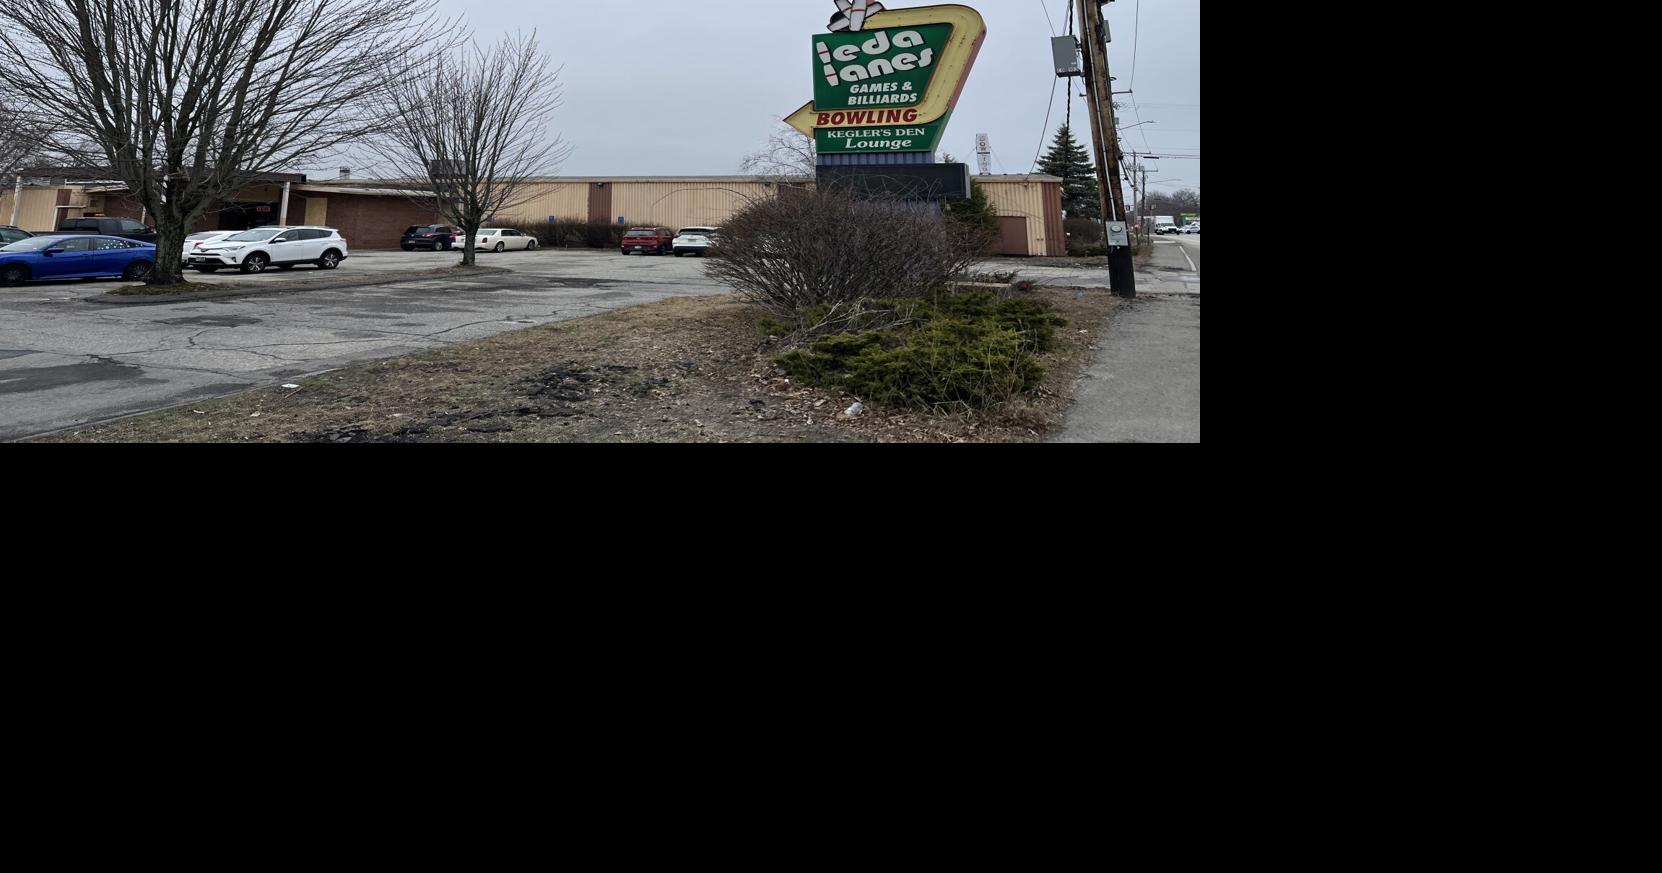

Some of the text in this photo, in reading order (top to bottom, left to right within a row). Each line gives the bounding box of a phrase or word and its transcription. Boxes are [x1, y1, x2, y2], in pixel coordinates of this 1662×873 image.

[850, 81, 912, 93] GAMES &
[848, 93, 917, 105] BILLIARDS
[816, 108, 917, 125] BOWLING
[827, 128, 925, 138] KEGLER'S DEN
[845, 138, 912, 149] Lounge
